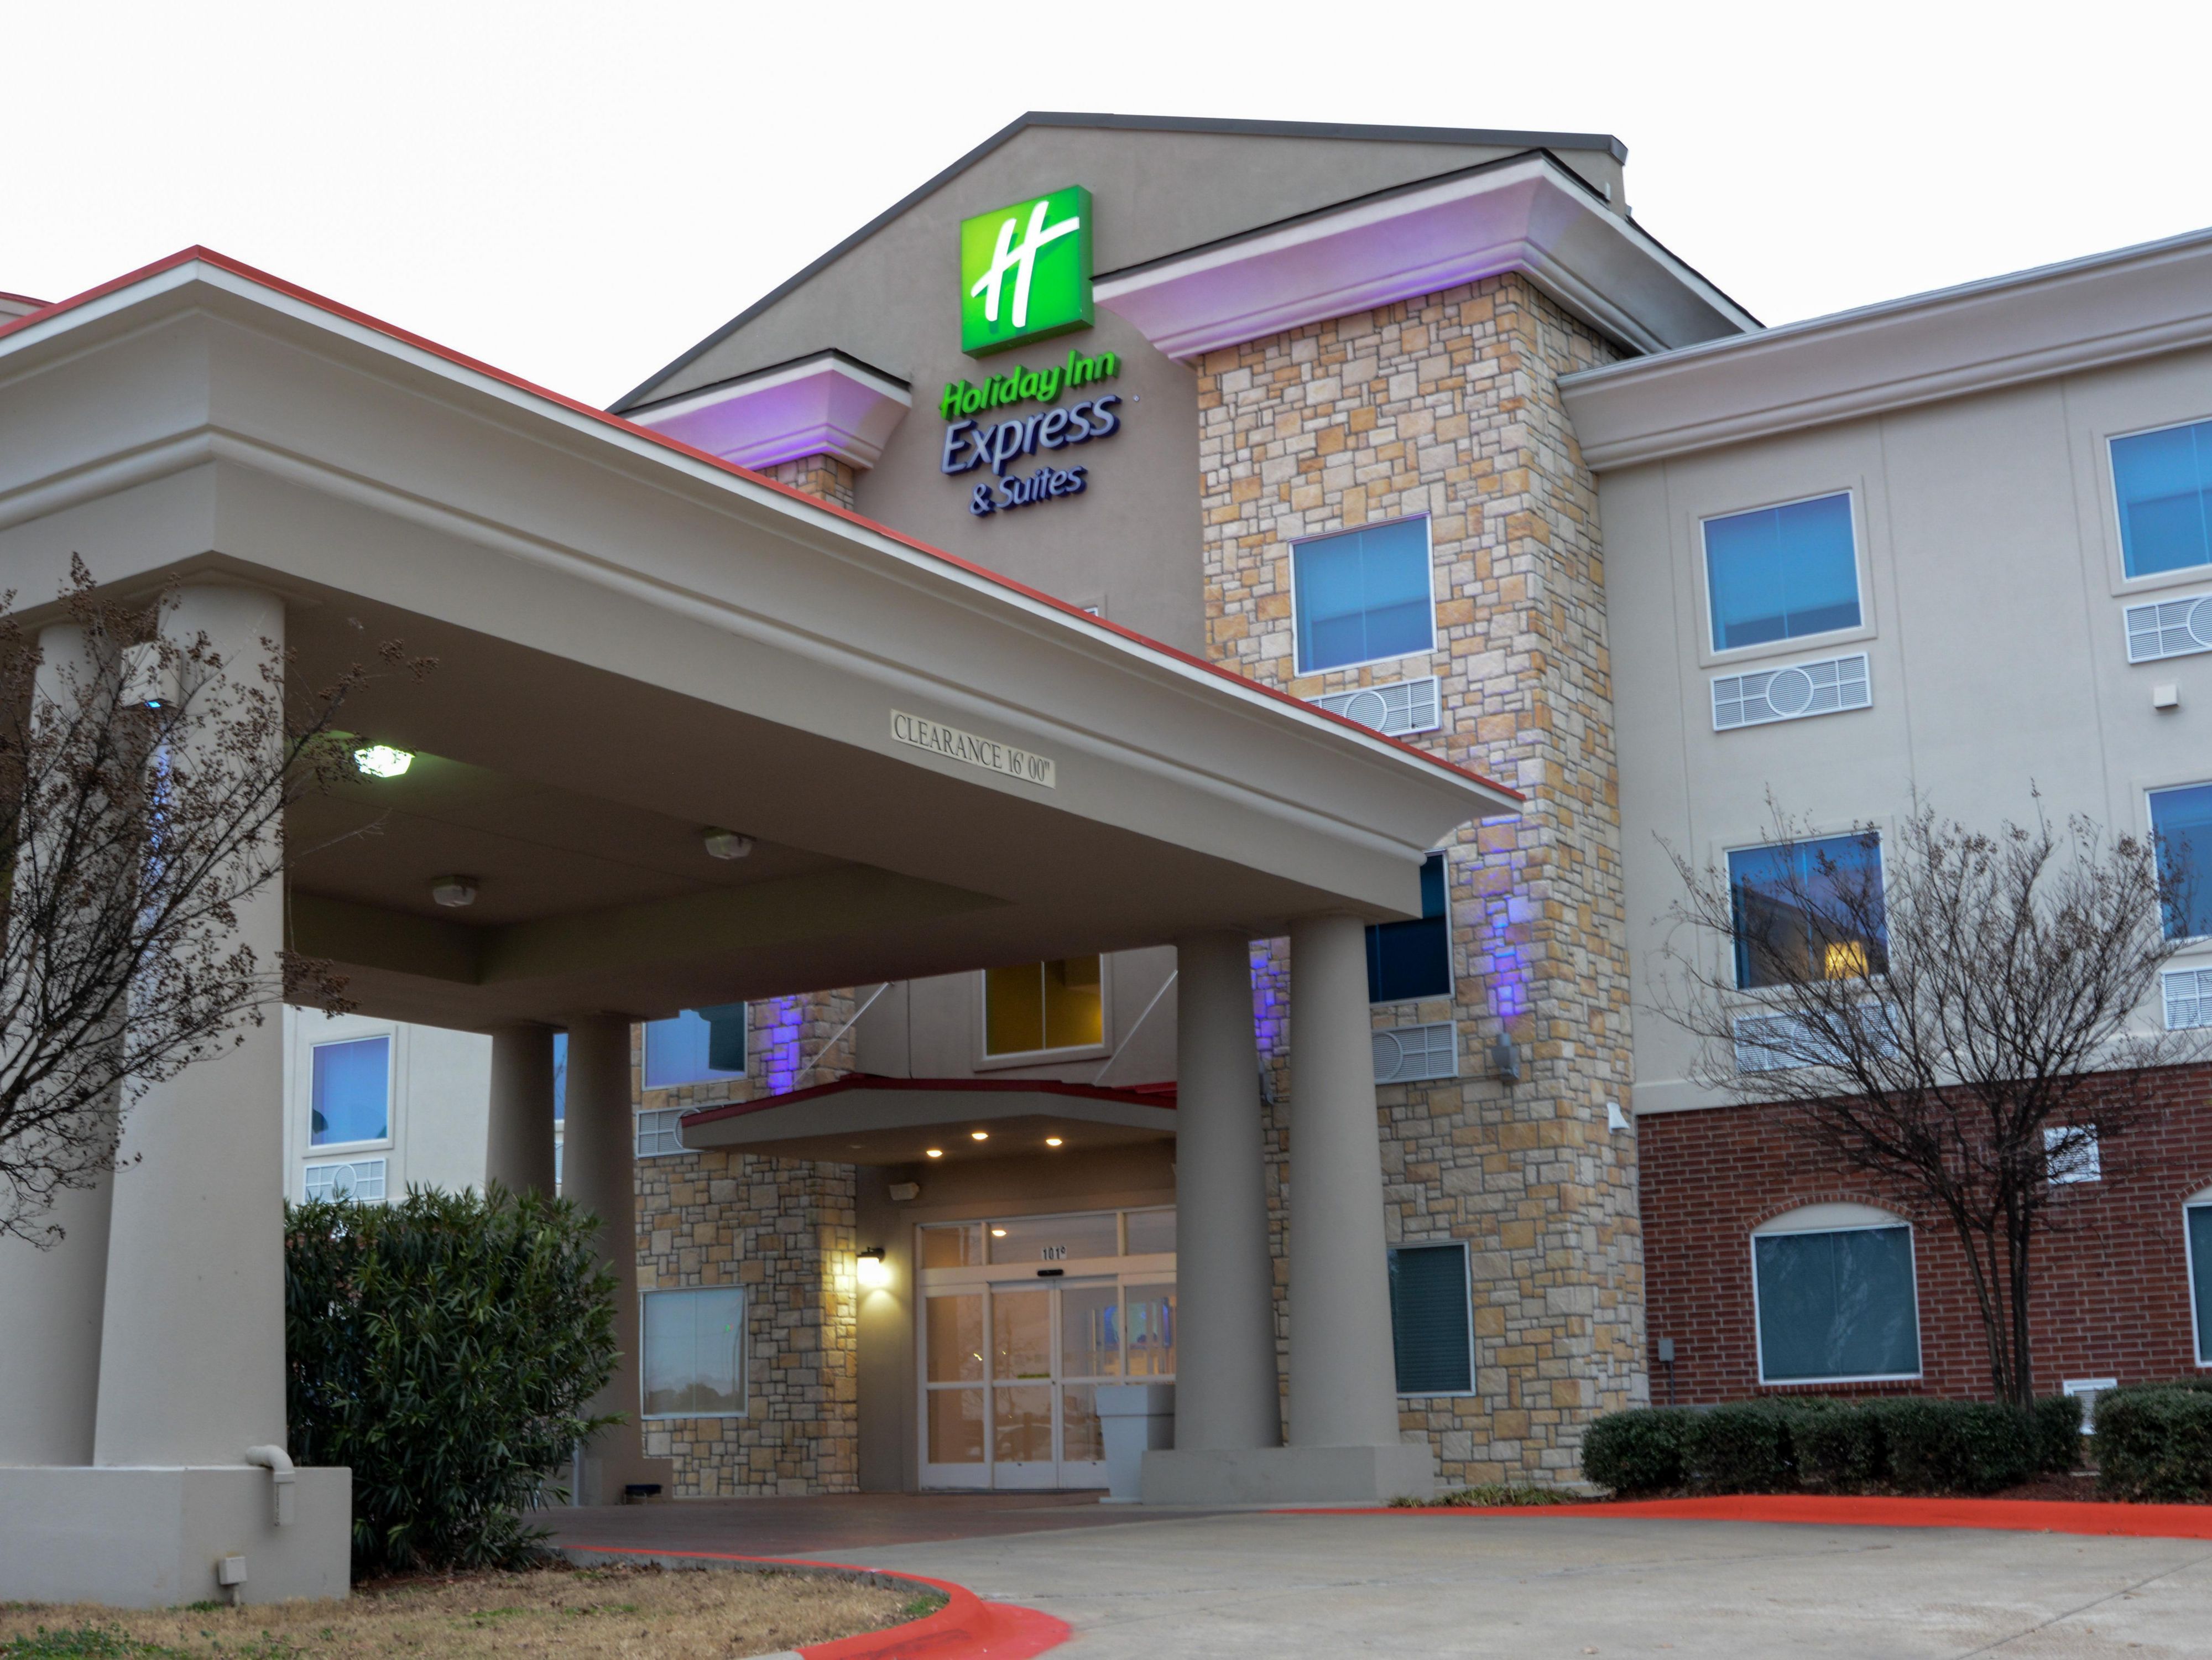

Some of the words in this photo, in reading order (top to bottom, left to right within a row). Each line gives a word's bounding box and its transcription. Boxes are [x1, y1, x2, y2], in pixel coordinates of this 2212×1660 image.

[940, 365, 1065, 421] Holiday
[1065, 350, 1121, 388] Inn
[940, 395, 1123, 476] Express
[969, 483, 995, 517] &
[997, 466, 1088, 509] Suites
[894, 715, 1003, 769] CLEARANCE
